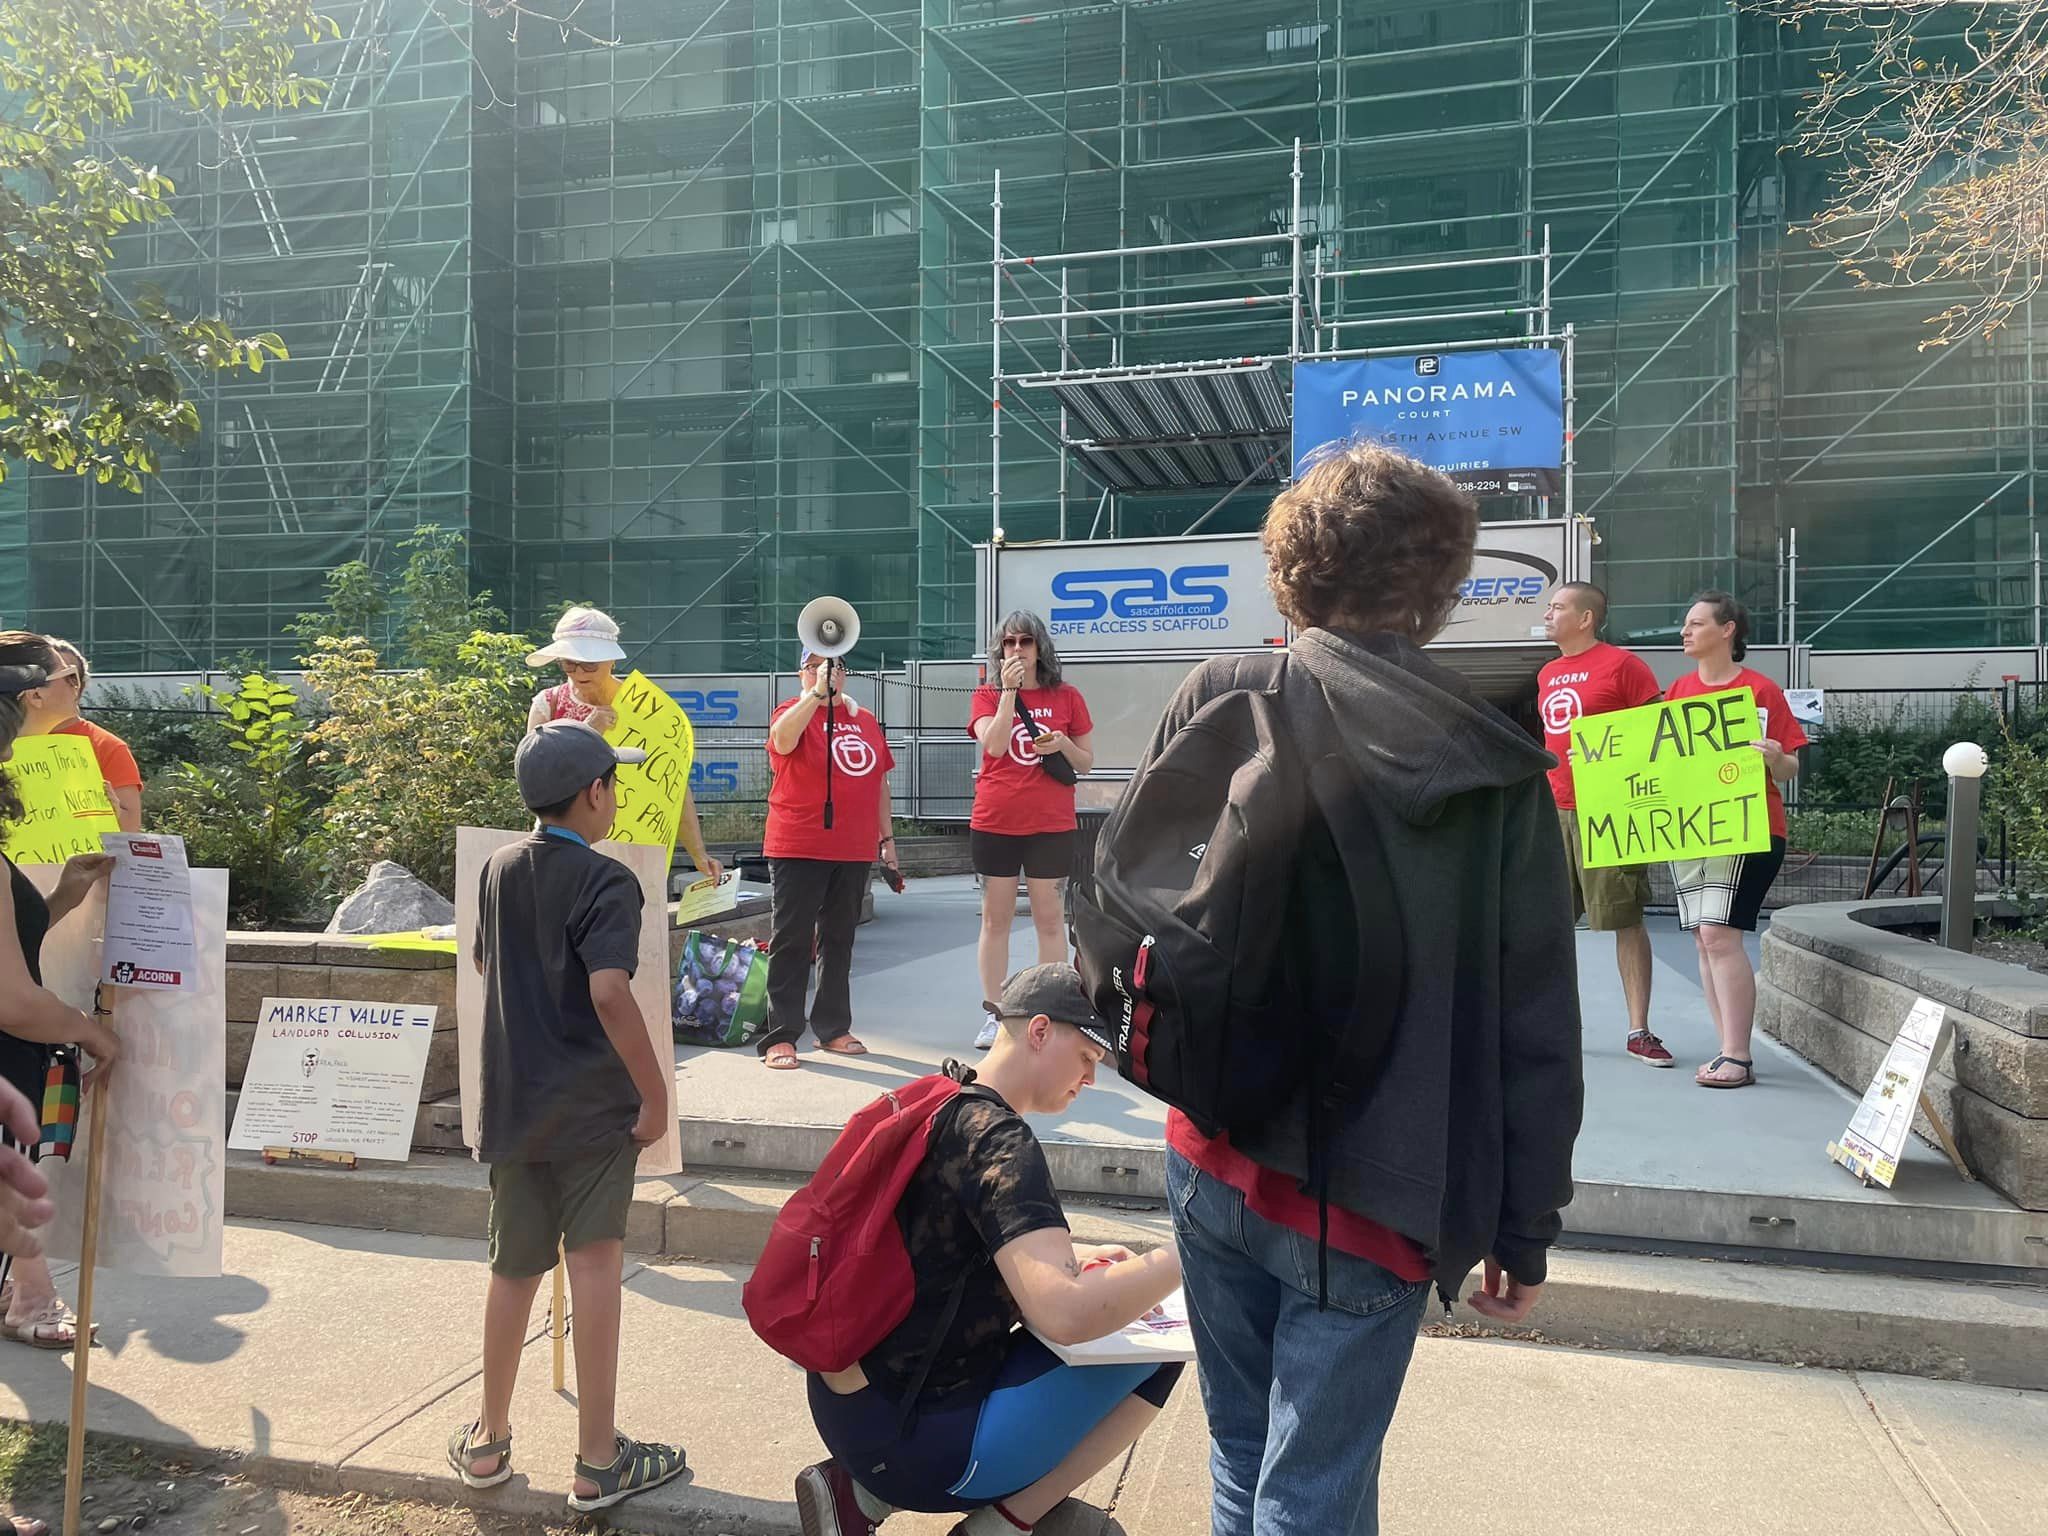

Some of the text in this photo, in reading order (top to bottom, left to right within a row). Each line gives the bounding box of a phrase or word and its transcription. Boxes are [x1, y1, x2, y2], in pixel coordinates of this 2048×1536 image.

[1342, 380, 1517, 408] PANORAMA
[1398, 409, 1452, 420] COURT
[1426, 429, 1490, 442] AVENUE
[1498, 426, 1523, 437] SW
[1427, 460, 1490, 473] NQUIRIES
[1461, 596, 1509, 606] GROUP
[1129, 604, 1211, 616] sascaffold.com
[1050, 617, 1229, 635] SAFE ACCESS SCAFFOLD
[1548, 671, 1589, 688] ACORN
[620, 682, 664, 721] MY
[1576, 694, 1752, 764] WE ARE
[1624, 772, 1663, 799] THE
[1587, 792, 1759, 863] MARKET
[137, 970, 174, 983] ACORN
[268, 1005, 342, 1024] MARKET
[349, 1007, 405, 1027] VALUE
[272, 1028, 401, 1040] LANDLORD COLLUSION
[291, 1131, 318, 1144] STOP
